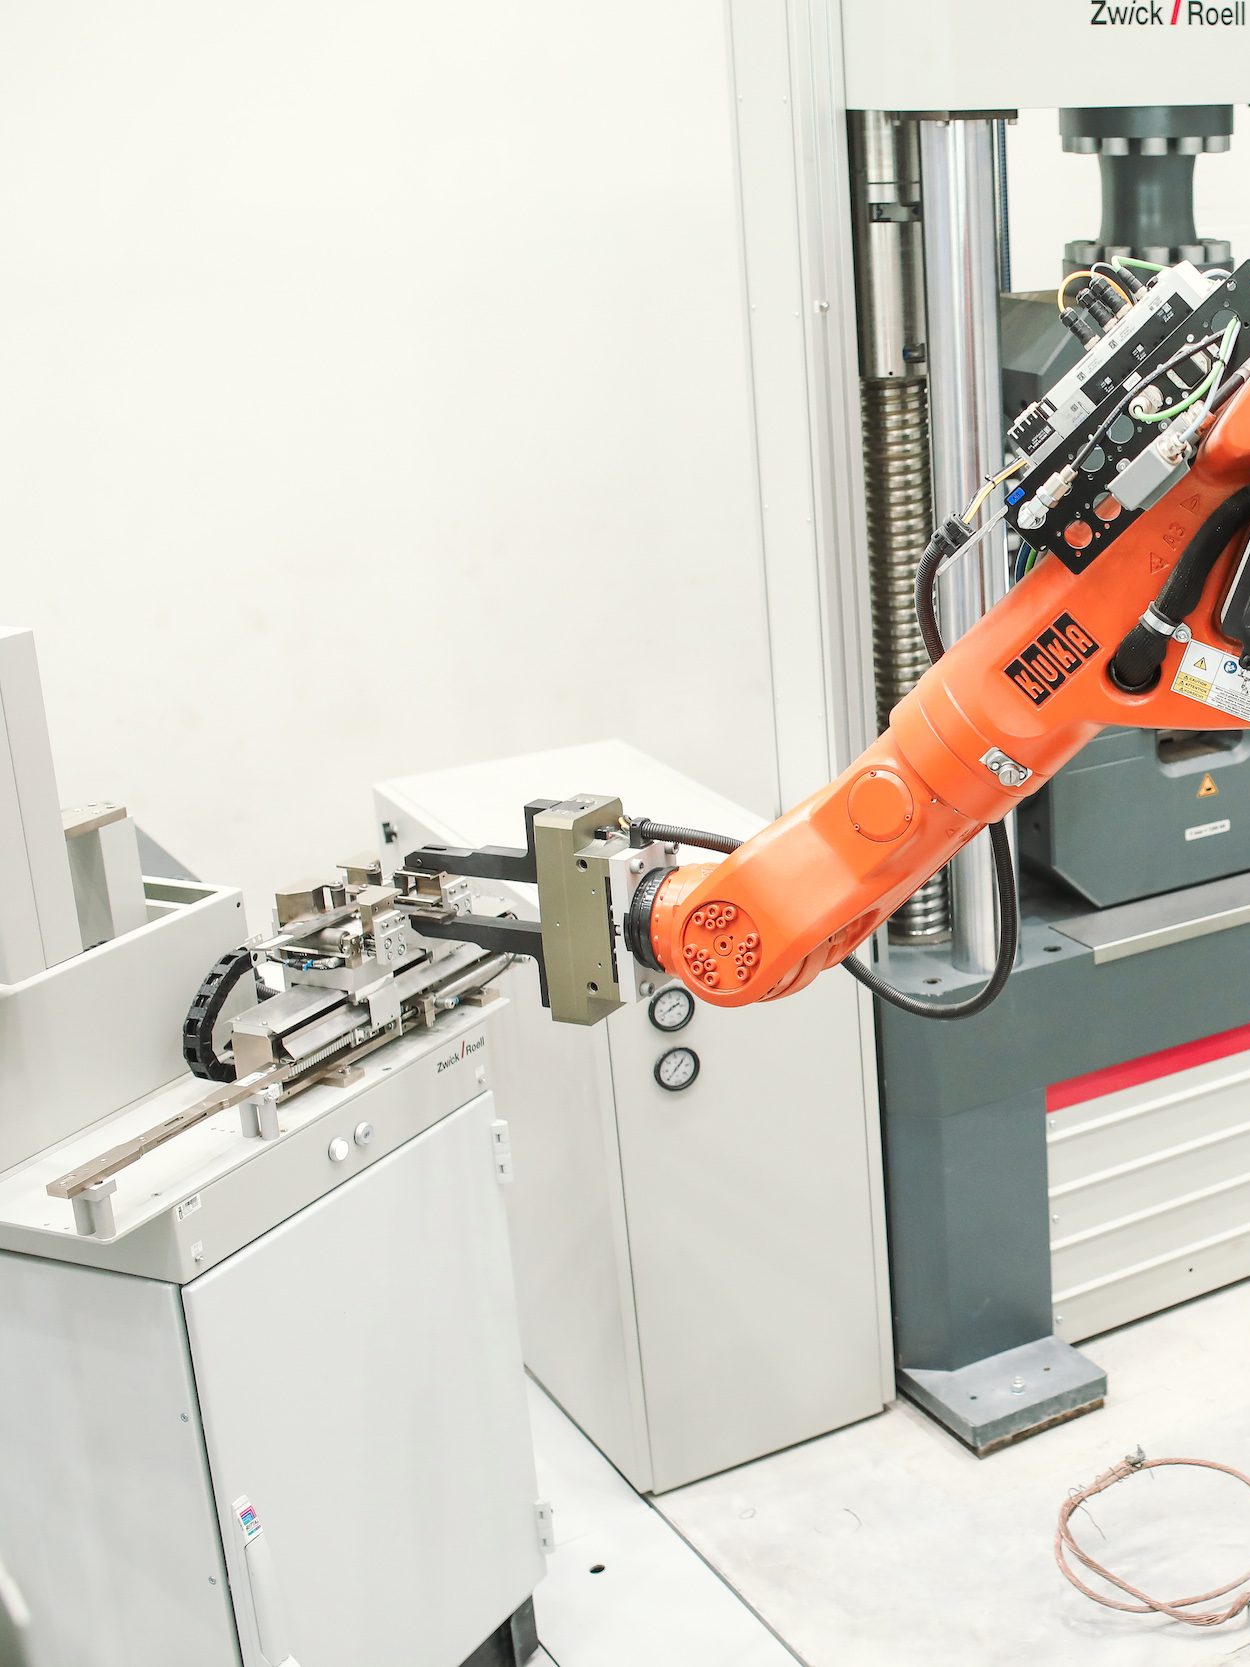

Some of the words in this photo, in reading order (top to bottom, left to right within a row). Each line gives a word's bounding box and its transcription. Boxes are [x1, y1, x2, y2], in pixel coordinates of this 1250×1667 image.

[1090, 0, 1164, 26] Zwick
[1187, 0, 1246, 26] Roell
[1162, 522, 1187, 551] A3
[1013, 623, 1094, 701] KUKA
[437, 1052, 460, 1073] Zwick
[465, 1036, 485, 1056] Roell
